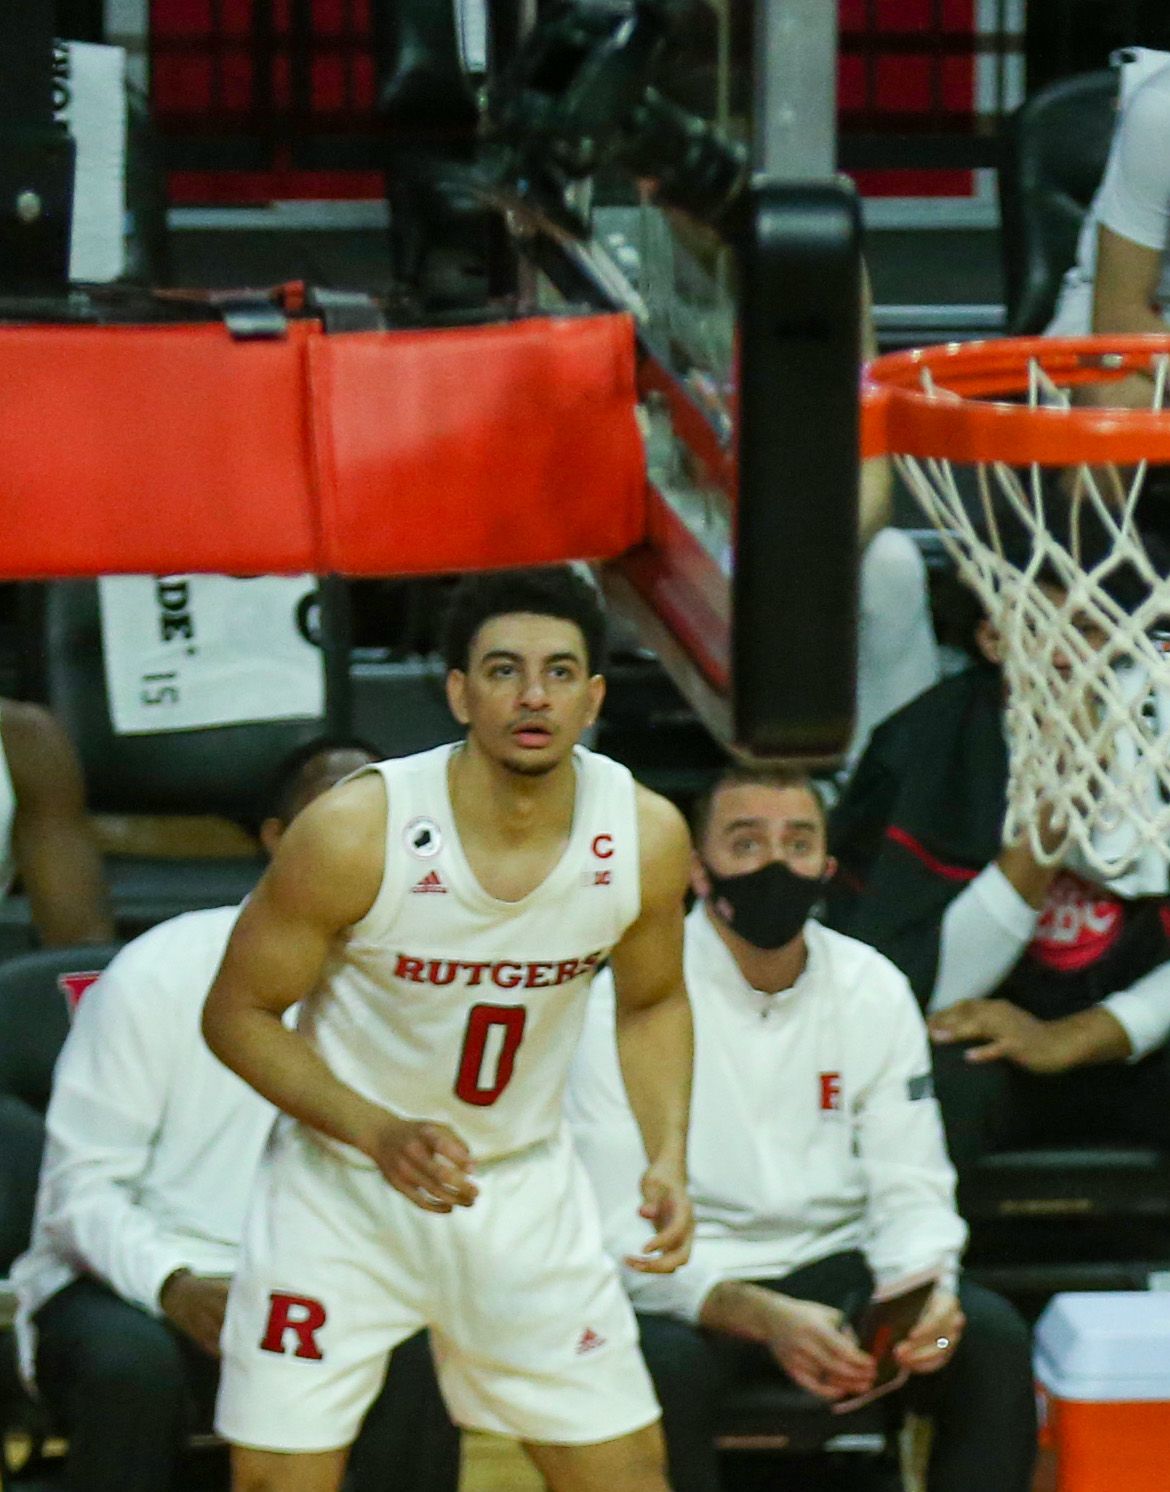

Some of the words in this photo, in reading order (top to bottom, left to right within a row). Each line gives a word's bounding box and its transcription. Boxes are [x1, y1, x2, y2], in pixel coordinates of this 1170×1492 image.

[591, 833, 615, 859] C
[454, 1002, 527, 1107] 0
[259, 1291, 327, 1361] R
